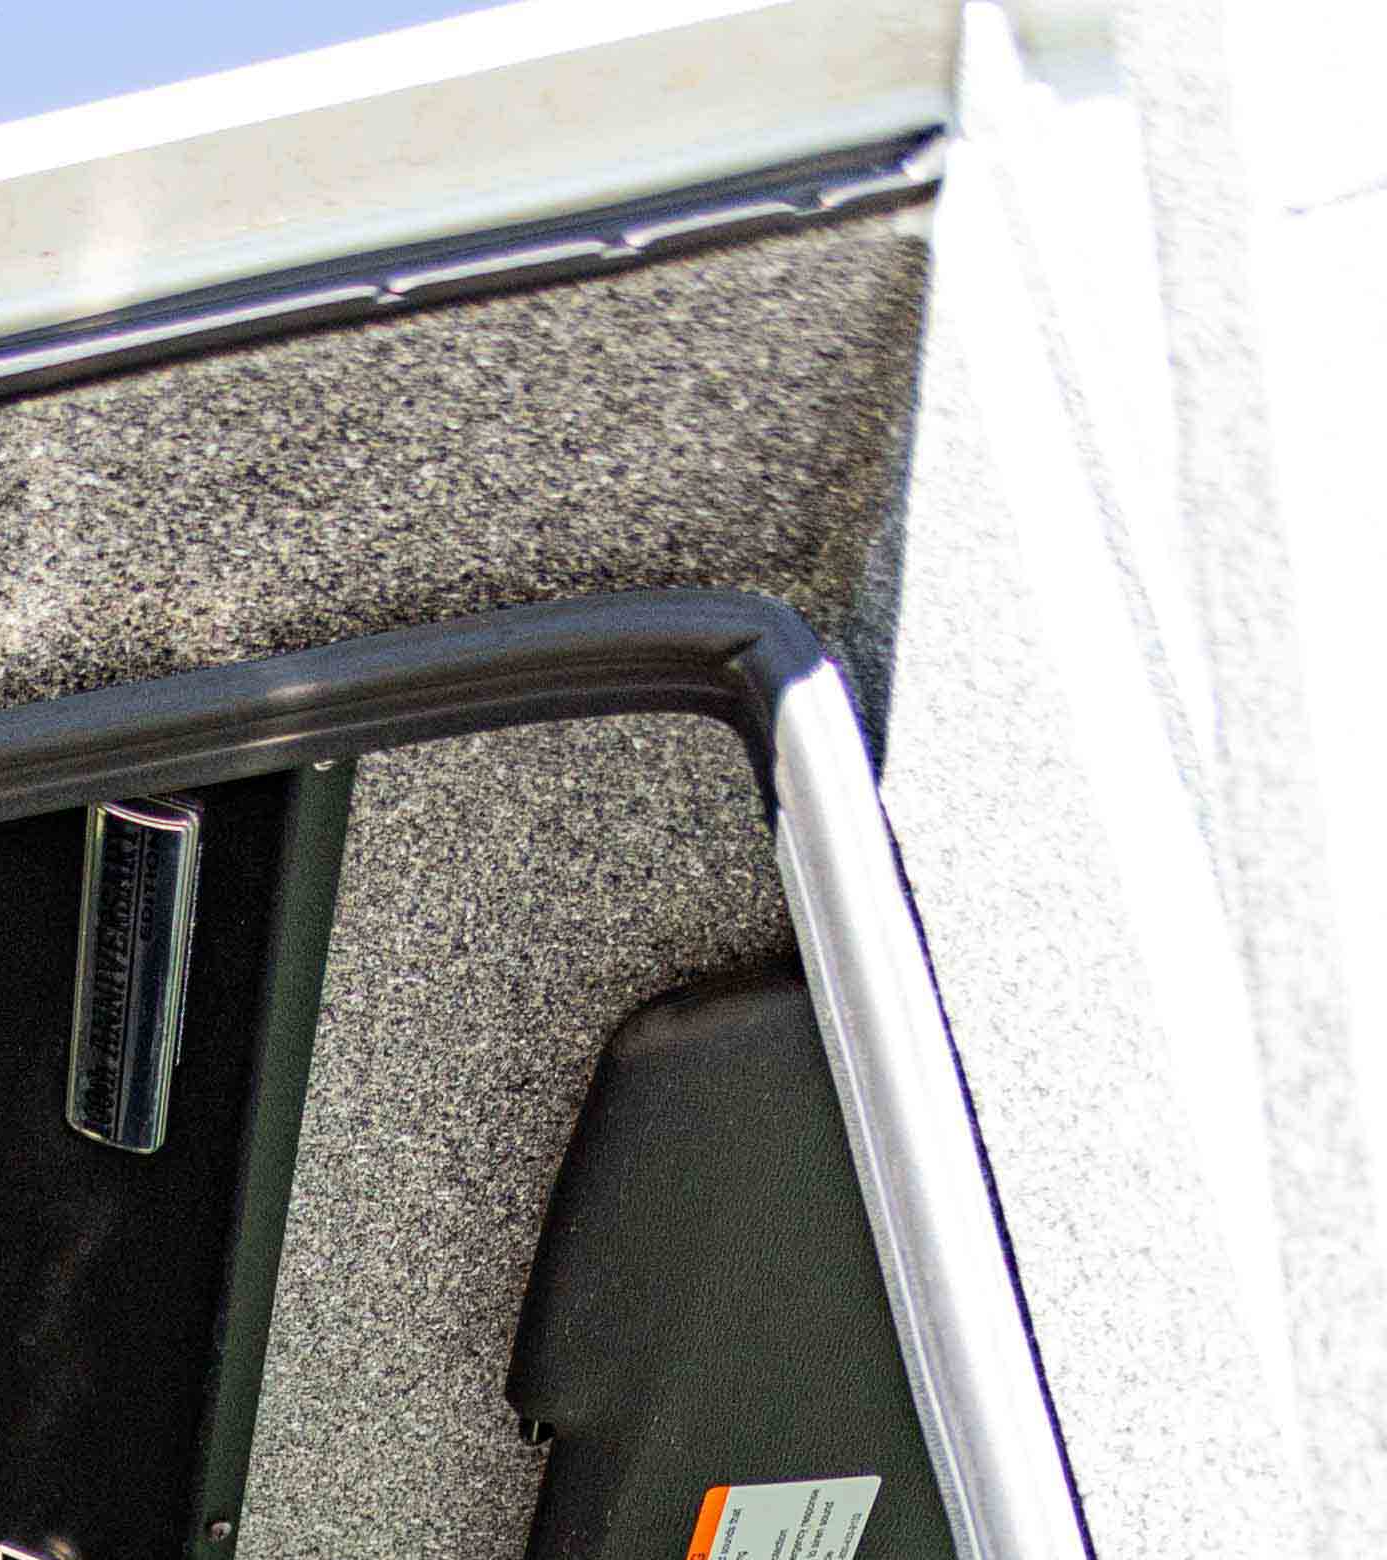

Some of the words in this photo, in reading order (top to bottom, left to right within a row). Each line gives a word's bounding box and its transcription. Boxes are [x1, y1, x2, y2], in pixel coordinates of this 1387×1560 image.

[139, 832, 156, 942] EDITION
[718, 1526, 736, 1553] sounds
[727, 1508, 742, 1524] that
